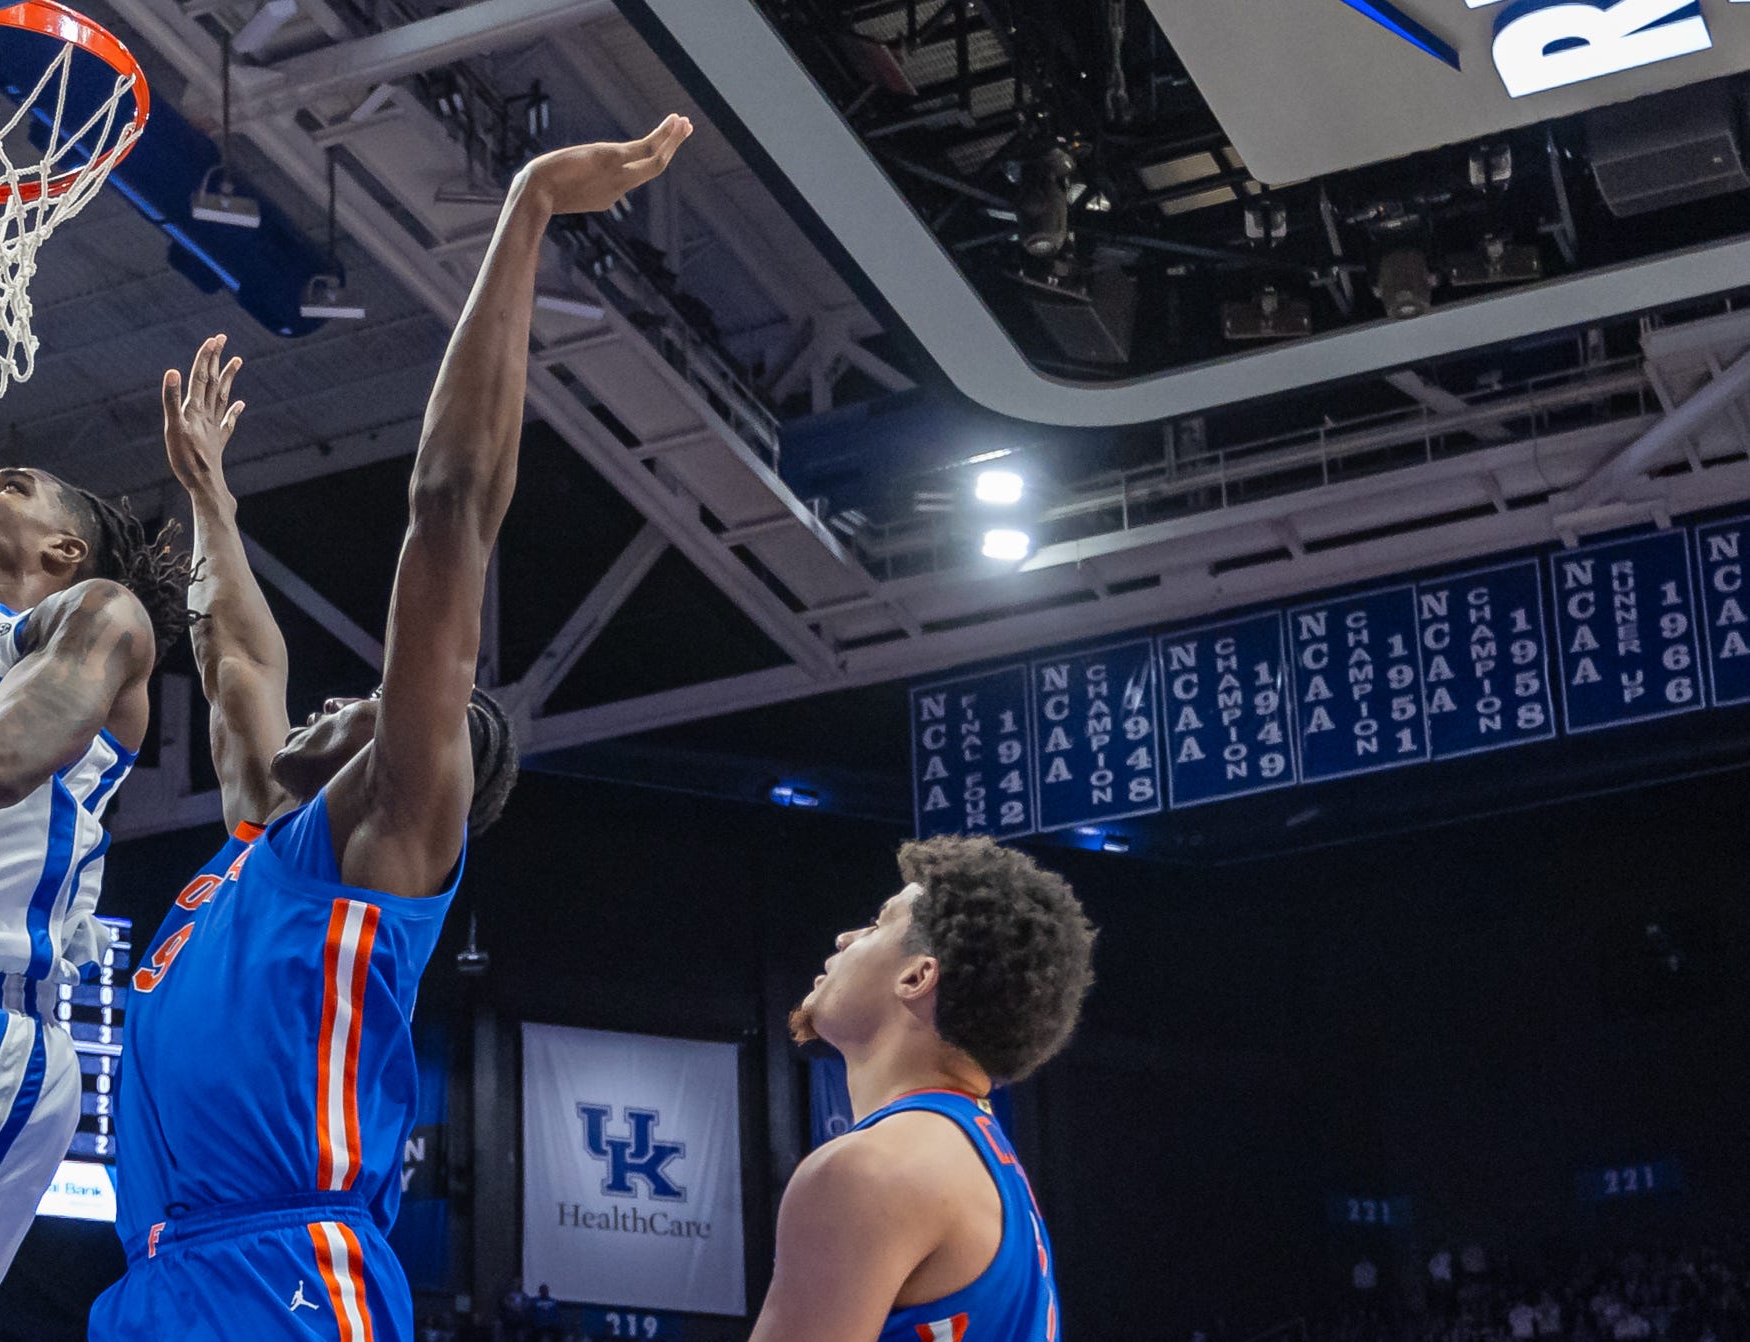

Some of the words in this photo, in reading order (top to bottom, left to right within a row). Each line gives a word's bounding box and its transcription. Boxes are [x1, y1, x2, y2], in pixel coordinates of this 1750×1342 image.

[1420, 590, 1458, 715] NCAA
[1467, 587, 1502, 734] CHAMPION
[1562, 558, 1602, 686] NCAA
[1611, 559, 1642, 657] RUNNER
[1659, 580, 1694, 703] 1966
[1041, 664, 1074, 784] NCAA
[1168, 642, 1206, 764] NCAA
[1214, 636, 1248, 780] CHAMPION
[1253, 661, 1286, 779] 1949
[1298, 611, 1336, 736] NCAA
[1345, 610, 1379, 756] CHAMPION
[1387, 634, 1418, 753] 1951
[1510, 607, 1545, 730] 1958
[1621, 669, 1645, 704] UP
[920, 693, 950, 812] NCAA
[961, 694, 982, 762] FINAL
[997, 709, 1025, 827] 1942
[1085, 664, 1114, 805] CHAMPION
[963, 773, 986, 829] FOUR
[100, 966, 114, 985] 2
[100, 985, 114, 1005] 0
[101, 1006, 112, 1025] 1
[132, 921, 196, 993] 9
[65, 1181, 103, 1197] Bank
[576, 1101, 688, 1203] UK
[1604, 1165, 1654, 1194] 221
[148, 1222, 166, 1259] F
[557, 1202, 712, 1240] HealthCare
